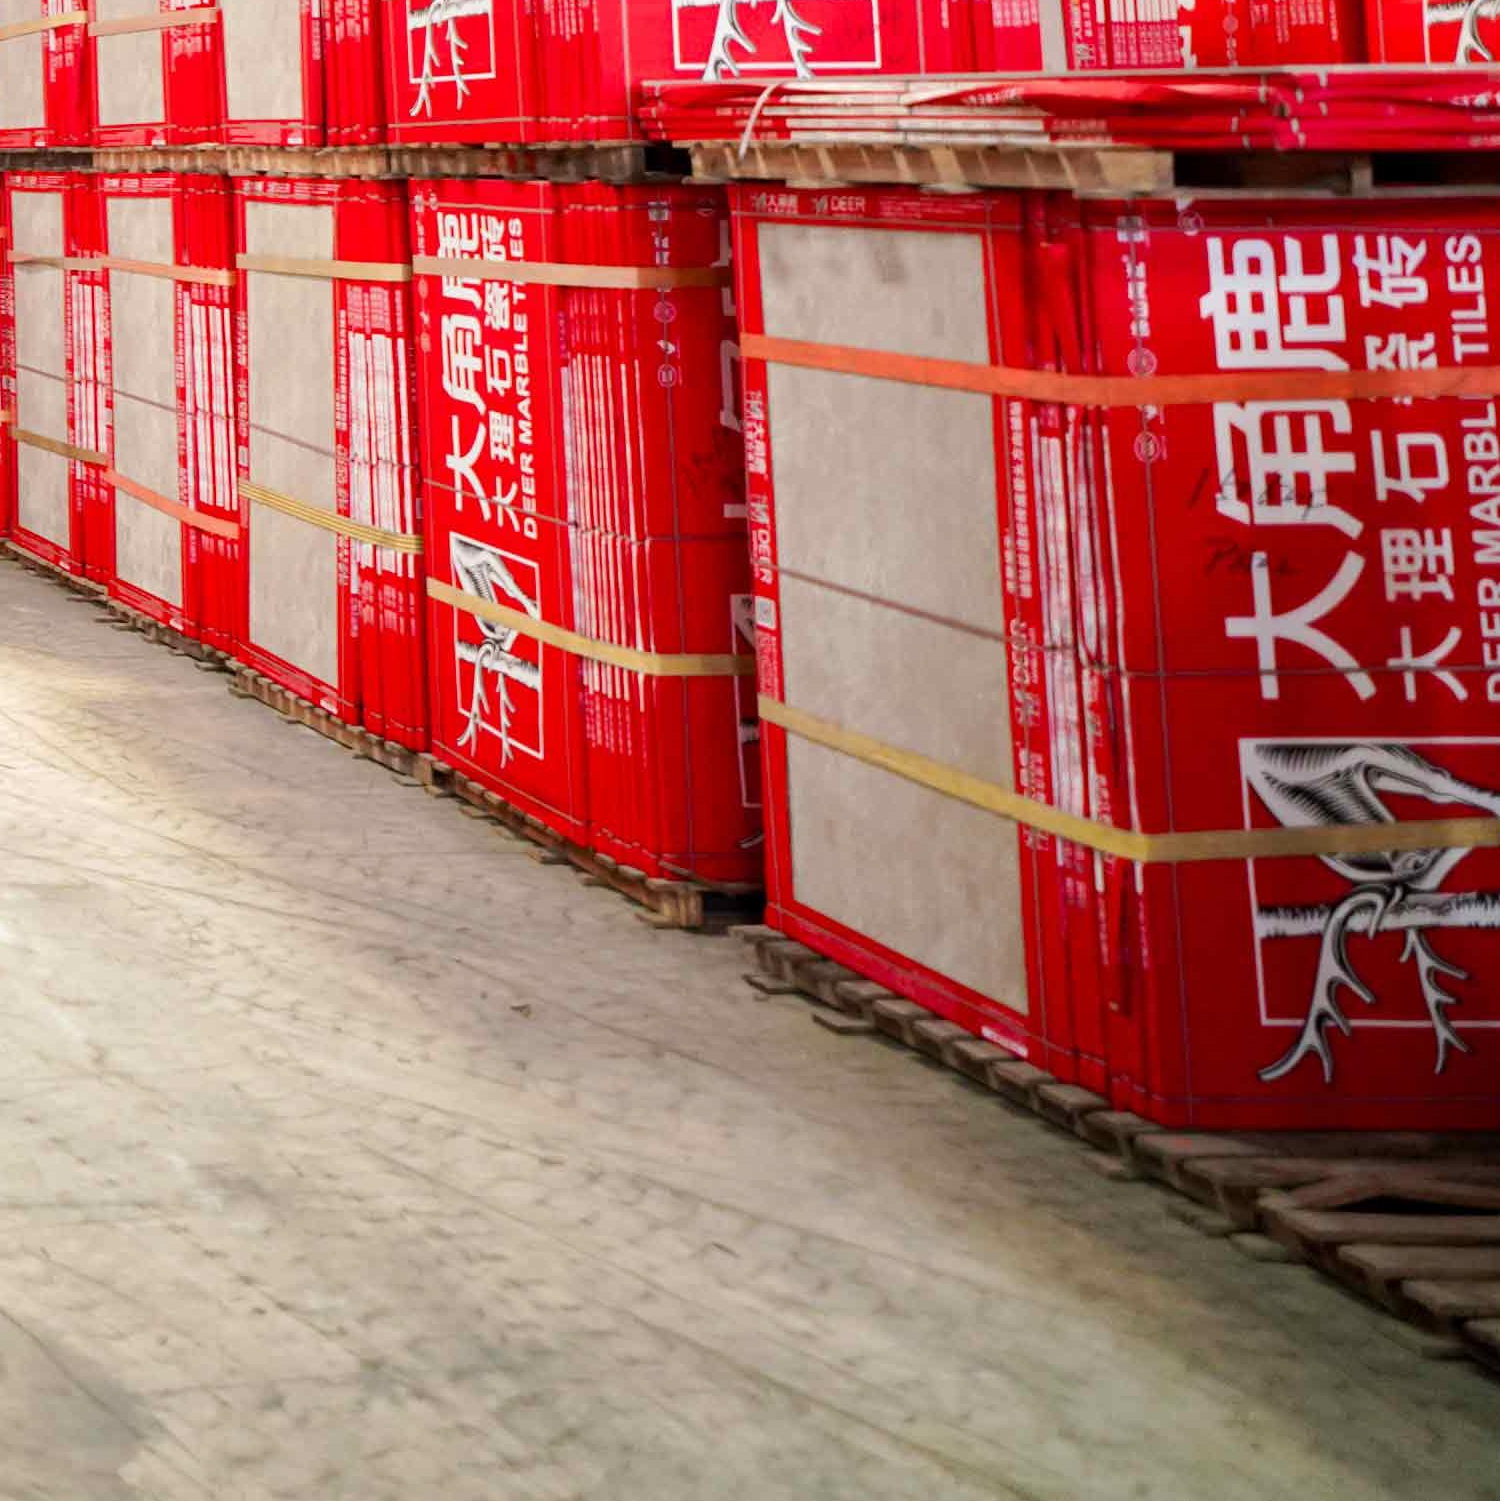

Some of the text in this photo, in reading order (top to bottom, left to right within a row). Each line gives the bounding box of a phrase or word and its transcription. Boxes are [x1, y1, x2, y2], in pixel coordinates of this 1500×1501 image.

[831, 196, 865, 211] DEER
[1445, 235, 1488, 362] TILES
[436, 211, 492, 522] 大角鹿
[508, 218, 538, 540] DEER MARBLE TIES
[1199, 234, 1377, 700] 大角鹿
[1352, 235, 1469, 701] 大理石瓷砖
[1461, 396, 1500, 564] MARBL
[758, 529, 773, 585] DEER
